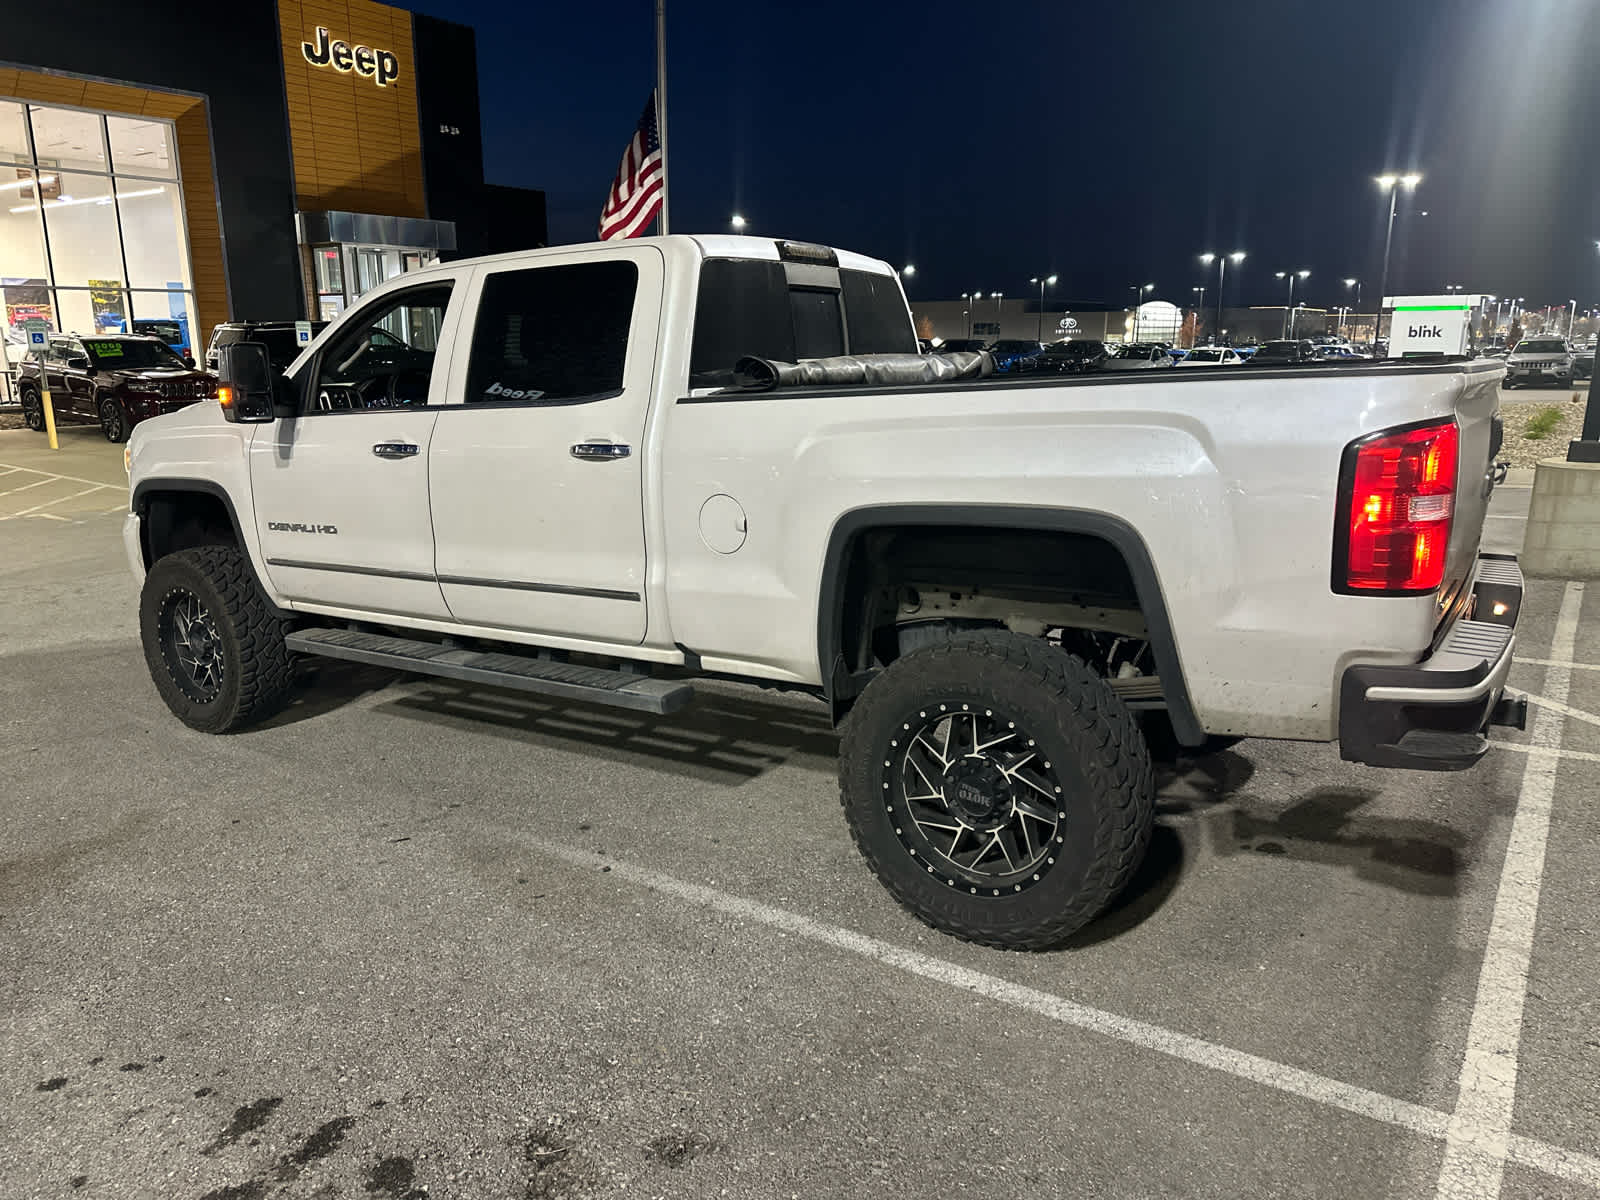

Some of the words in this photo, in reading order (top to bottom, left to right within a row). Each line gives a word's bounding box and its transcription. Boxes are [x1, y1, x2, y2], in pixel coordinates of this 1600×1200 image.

[302, 26, 399, 87] Jeep
[1408, 325, 1443, 338] blink
[268, 522, 316, 533] DENALI
[317, 525, 338, 535] HD
